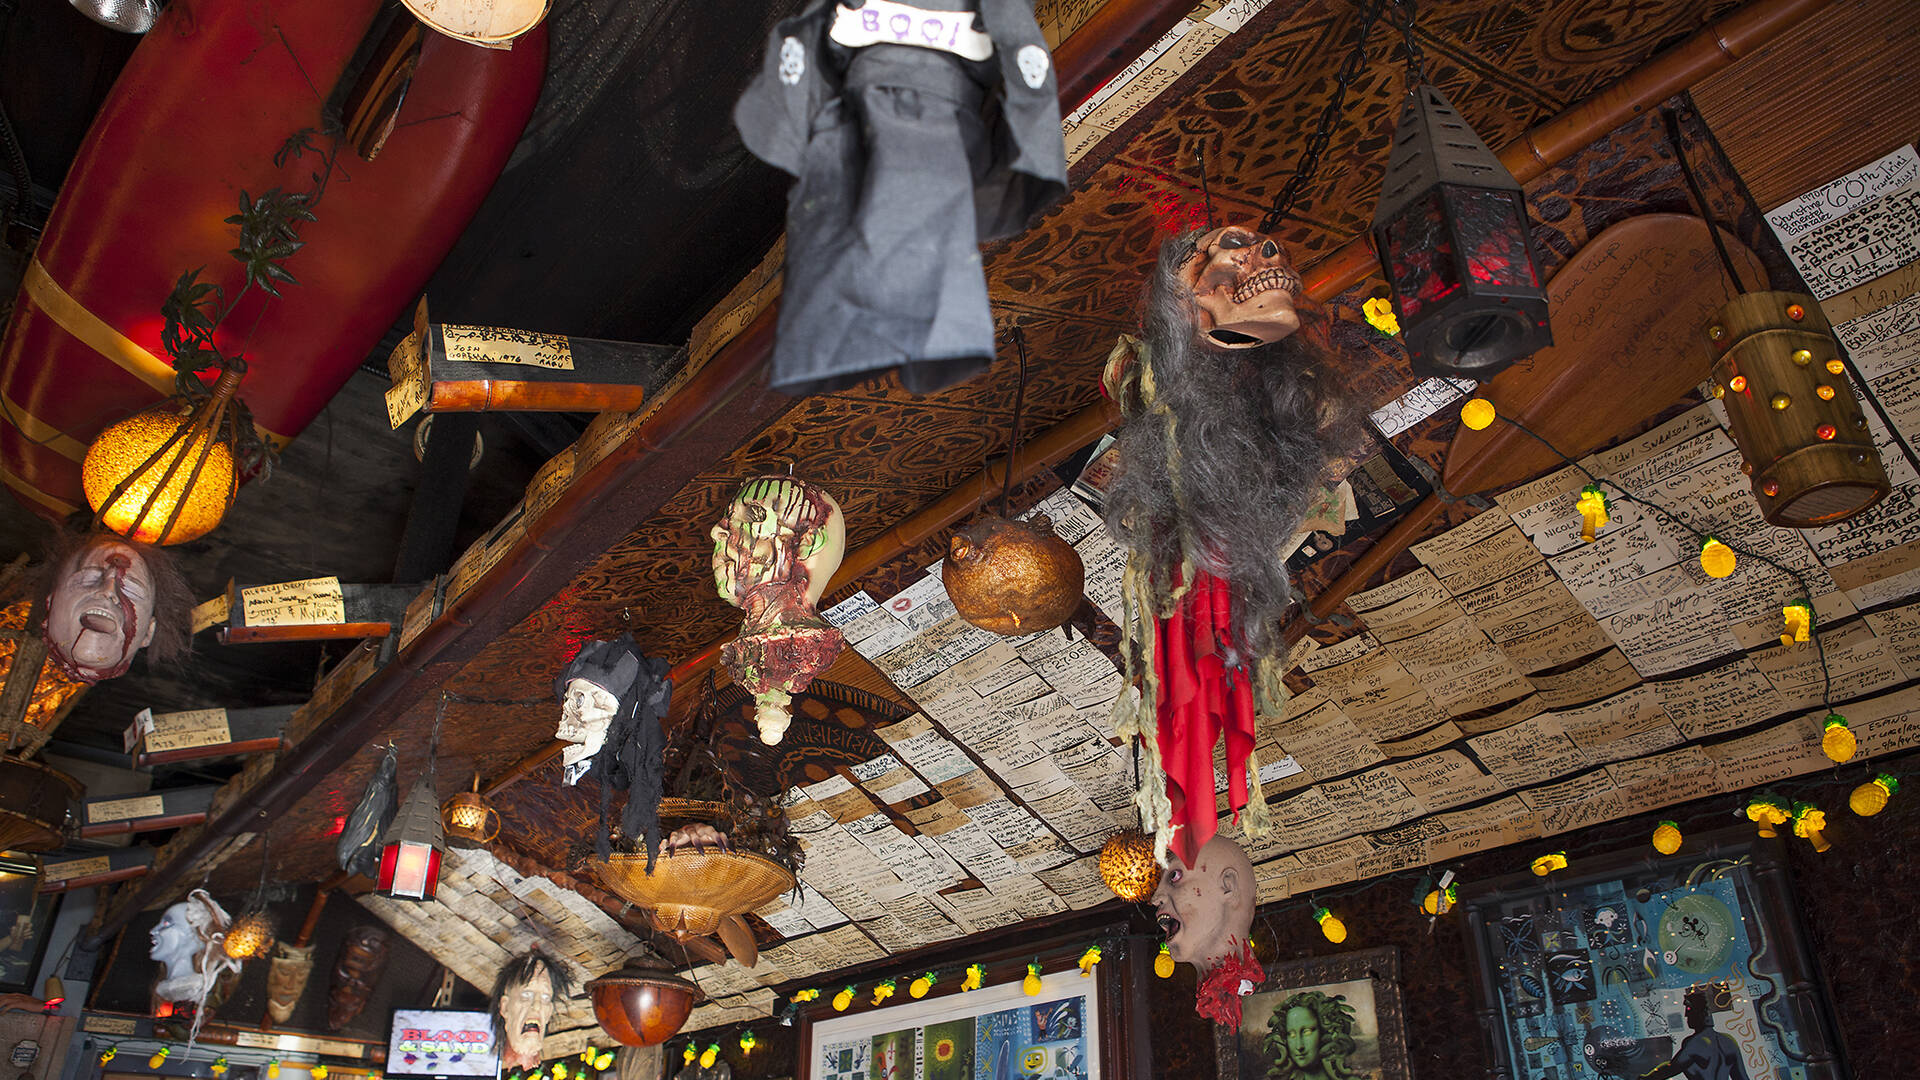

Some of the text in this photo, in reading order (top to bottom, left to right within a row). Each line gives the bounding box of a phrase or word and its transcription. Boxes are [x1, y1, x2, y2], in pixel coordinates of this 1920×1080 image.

[1772, 200, 1824, 226] Christine
[1828, 254, 1860, 278] Gil
[500, 354, 521, 363] 1976
[1649, 443, 1713, 478] HERNANDEZ
[1055, 509, 1094, 539] DANIEL V
[1466, 592, 1501, 611] MICHAEL
[1360, 770, 1390, 790] Rose
[1458, 839, 1481, 851] 1967
[402, 1029, 489, 1043] BLOOD
[400, 1040, 489, 1053] & SAND
